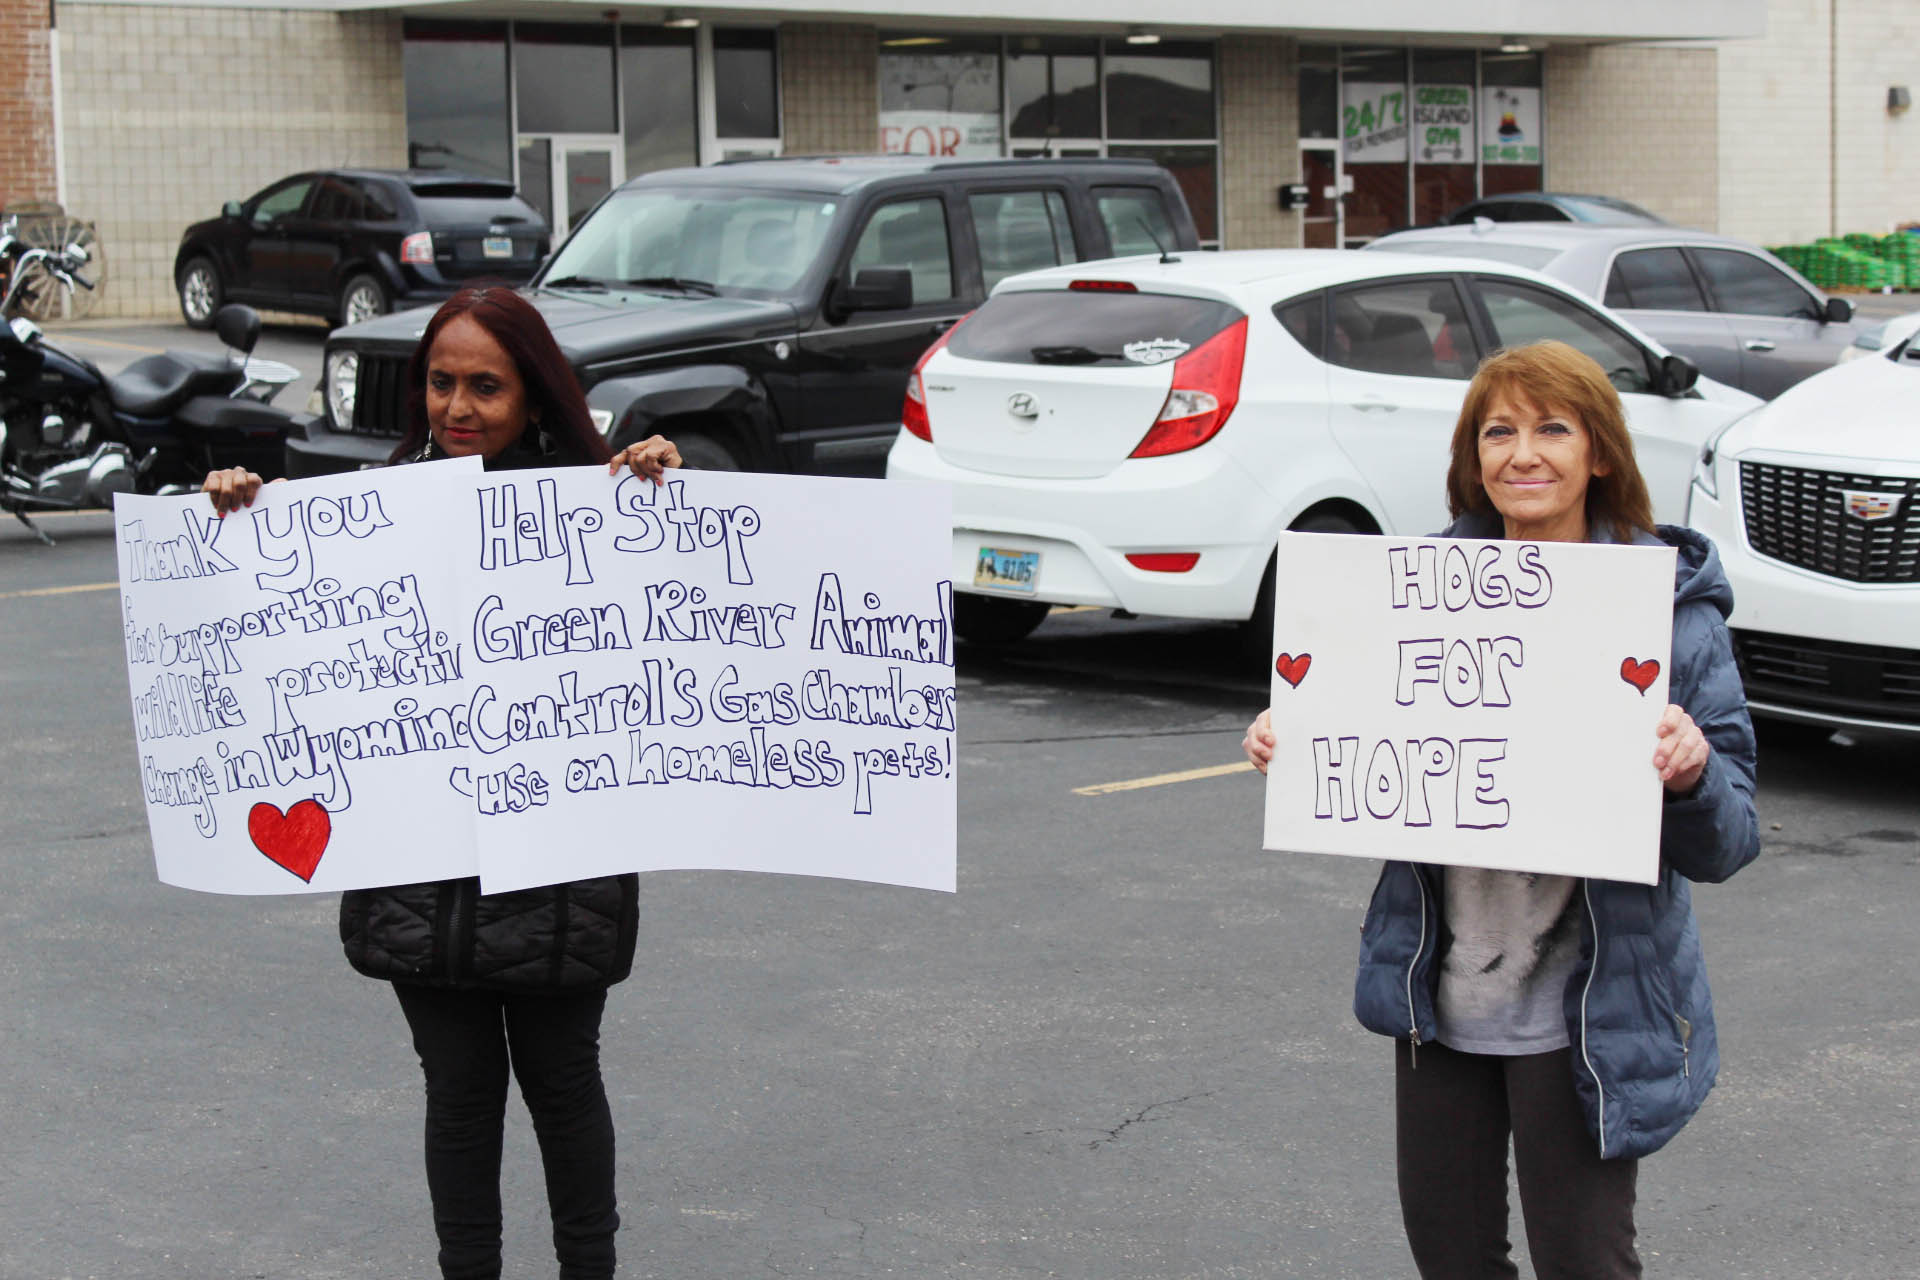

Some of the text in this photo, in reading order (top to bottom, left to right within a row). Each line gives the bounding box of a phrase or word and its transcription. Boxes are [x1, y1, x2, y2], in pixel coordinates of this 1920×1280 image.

[1343, 91, 1403, 137] 24/7
[1414, 107, 1470, 124] ISLAND
[1416, 87, 1468, 104] GREEN
[1426, 127, 1460, 145] GYM
[122, 508, 239, 583] Thank
[477, 474, 760, 585] Help Stop
[1388, 544, 1553, 612] HOGS
[474, 573, 954, 667] Green River Animal
[468, 657, 956, 753] Control's Gas Chamber
[216, 741, 269, 792] in
[478, 727, 951, 815] use on homeless pets!
[1312, 736, 1510, 829] HOPE
